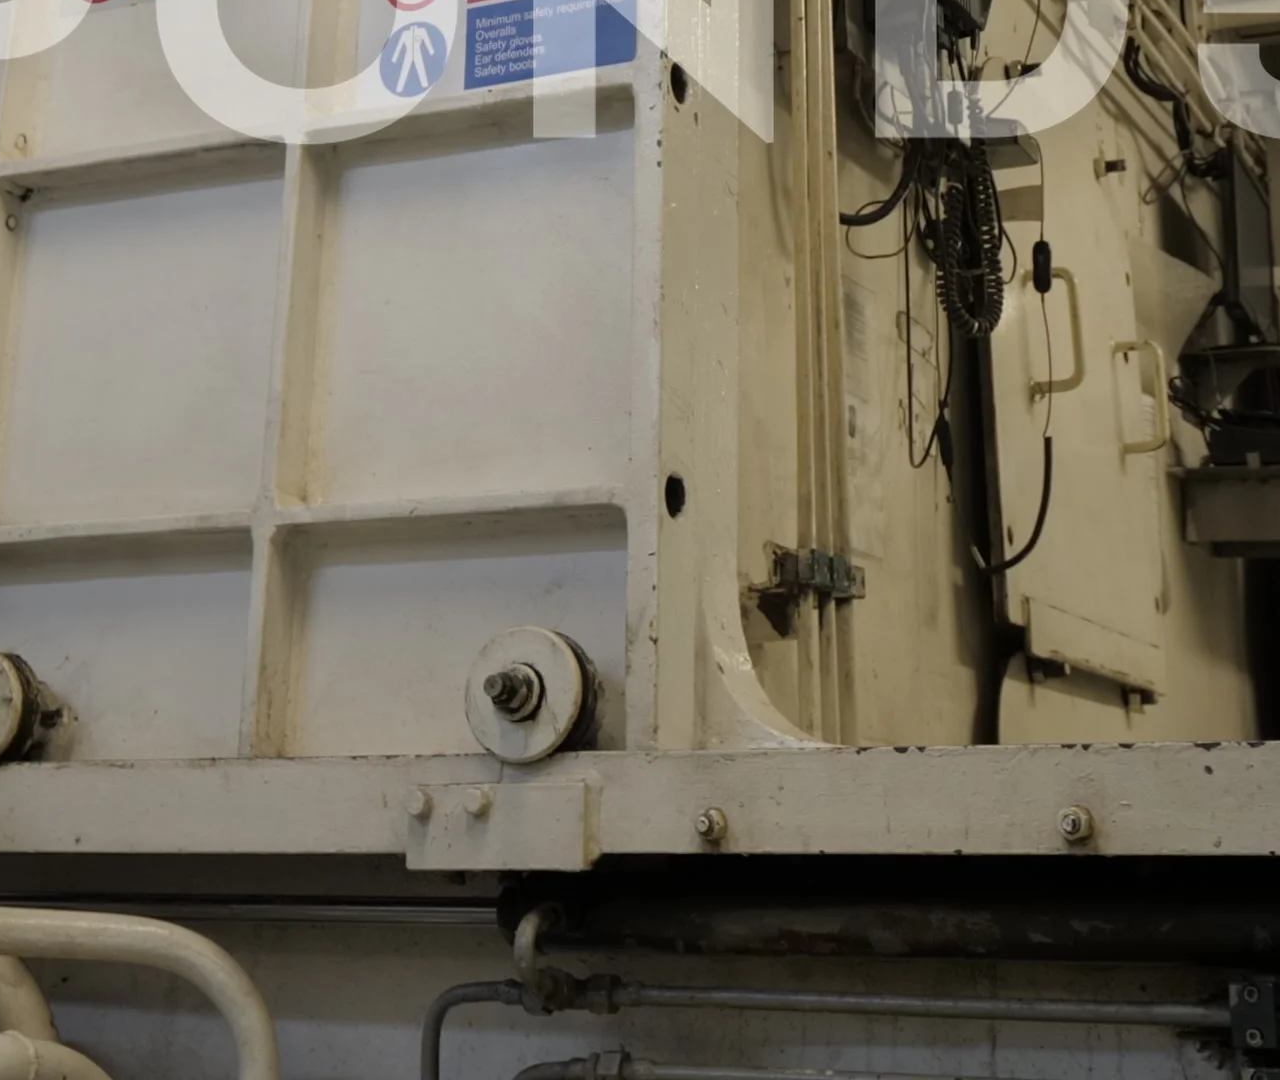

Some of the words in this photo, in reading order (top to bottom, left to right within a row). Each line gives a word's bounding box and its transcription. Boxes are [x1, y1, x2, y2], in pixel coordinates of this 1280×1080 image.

[476, 13, 521, 29] Minimum
[524, 6, 554, 20] safety
[476, 25, 516, 41] Overalls
[475, 39, 506, 53] Safety
[510, 34, 542, 48] gloves
[475, 54, 492, 66] Ear
[494, 45, 545, 62] defenders
[474, 64, 506, 78] Safety
[509, 59, 537, 72] boots
